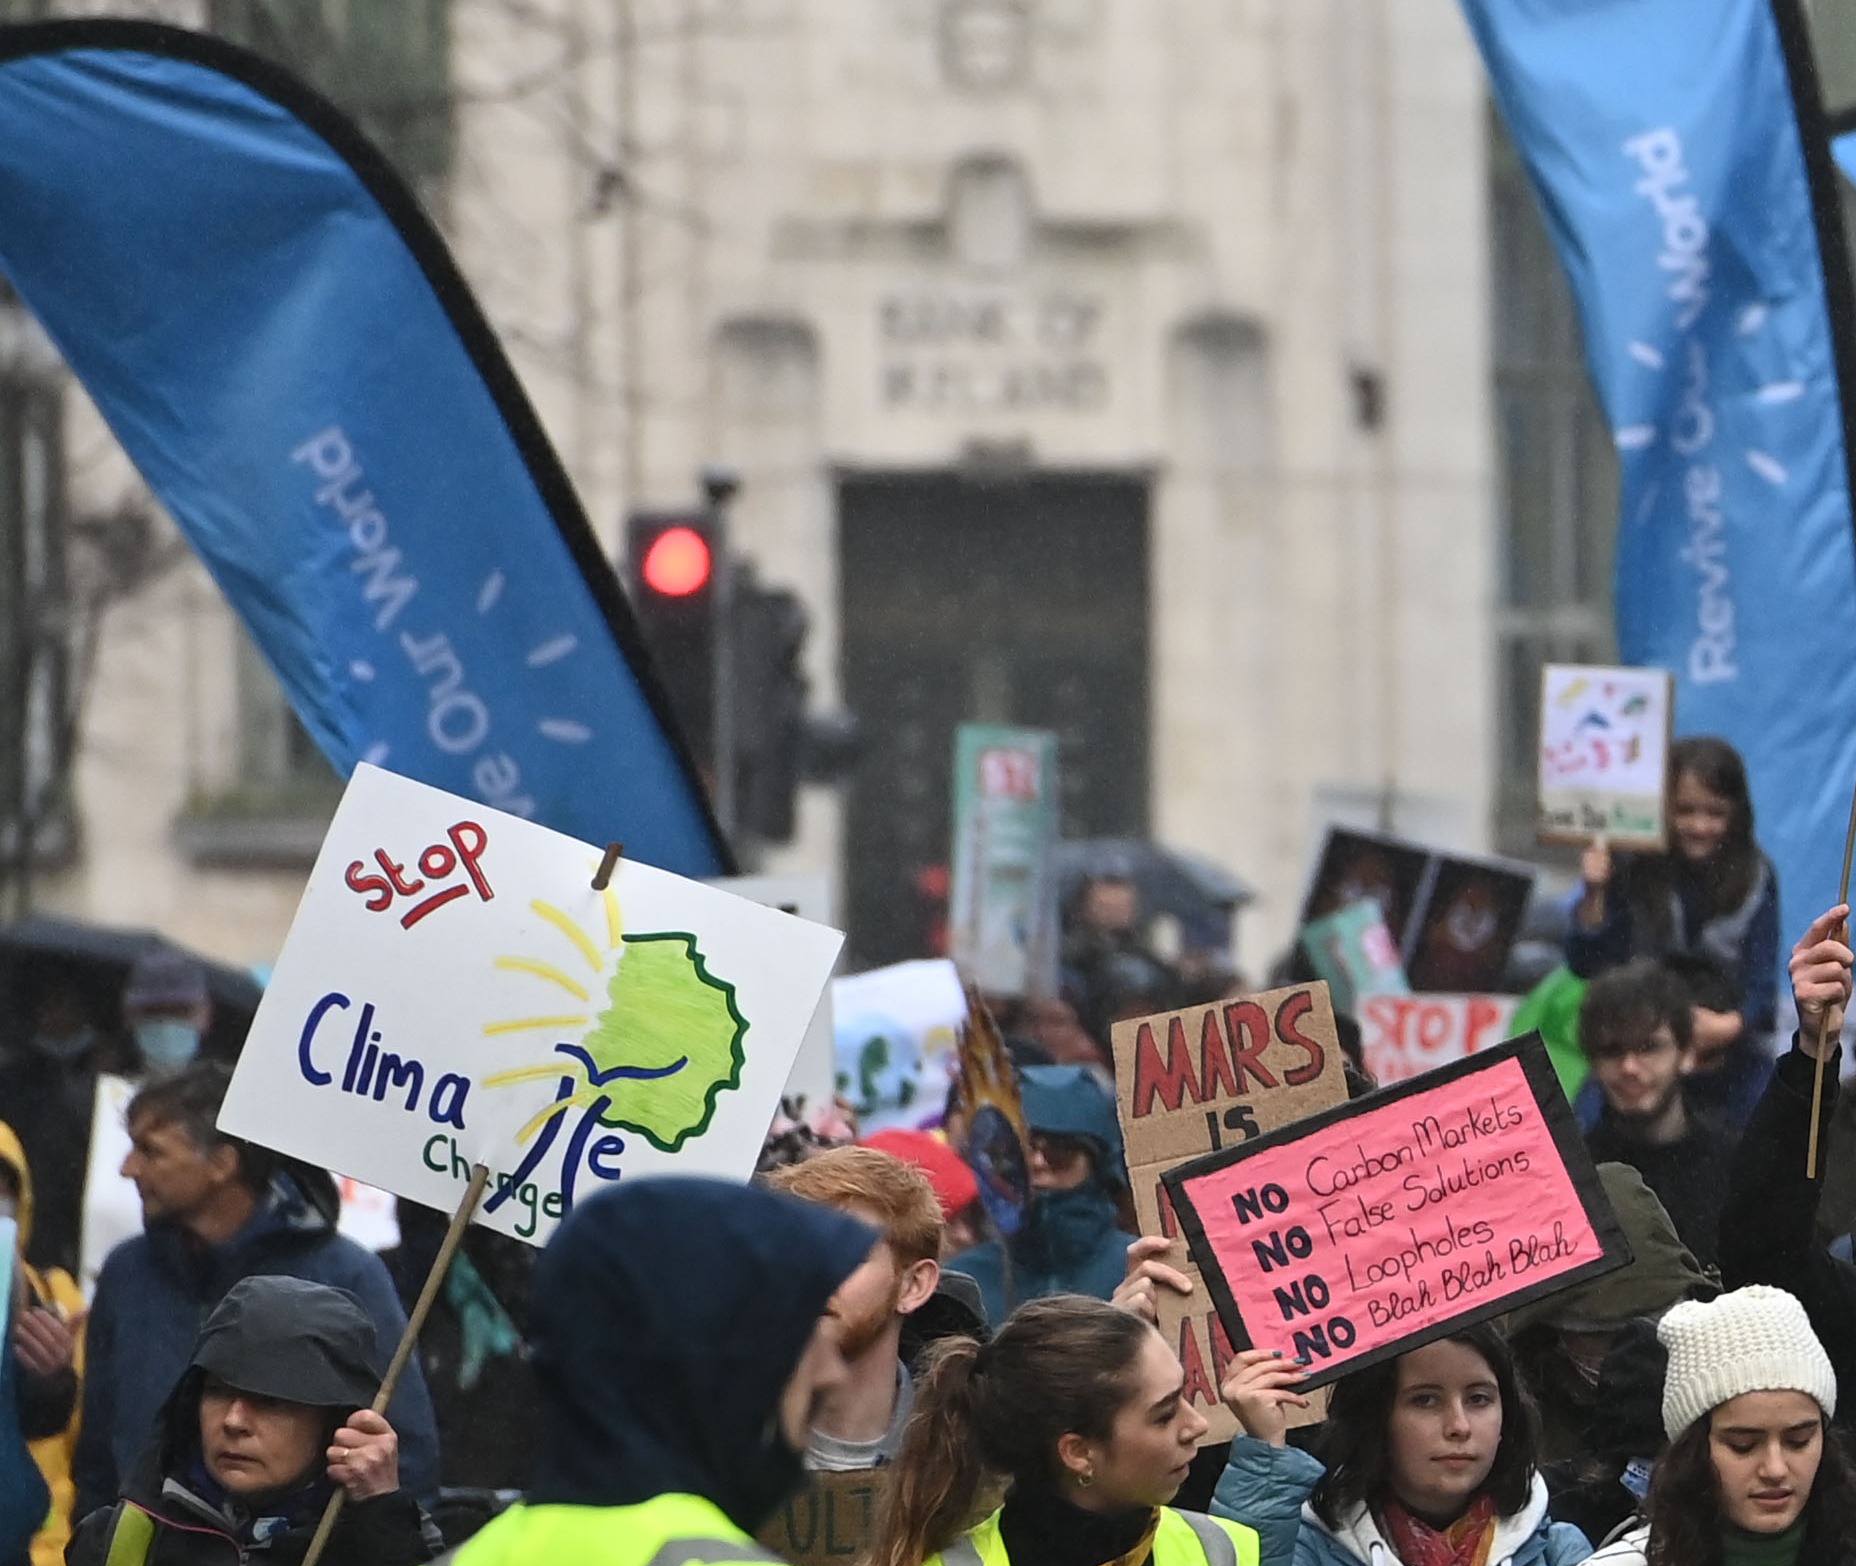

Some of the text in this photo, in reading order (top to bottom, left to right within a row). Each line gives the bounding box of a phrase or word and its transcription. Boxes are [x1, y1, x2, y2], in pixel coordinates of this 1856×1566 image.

[1623, 127, 1712, 329] World
[292, 425, 490, 756] Our World
[1686, 465, 1738, 684] Revive
[346, 821, 494, 912] Stop
[1131, 990, 1325, 1119] MARS
[1365, 998, 1502, 1055] STOP
[423, 1133, 564, 1238] Chnge
[1205, 1105, 1261, 1151] IS
[1231, 1183, 1290, 1226] NO
[1306, 1144, 1414, 1198] Carbon
[1412, 1097, 1524, 1158] Markets
[1251, 1150, 1530, 1274] NO False Solutions
[1273, 1215, 1495, 1321] NO Loopholes
[1292, 1316, 1357, 1365] NO
[1367, 1279, 1437, 1329] Blah
[1441, 1253, 1507, 1301] Blah
[1509, 1220, 1579, 1275] Blah
